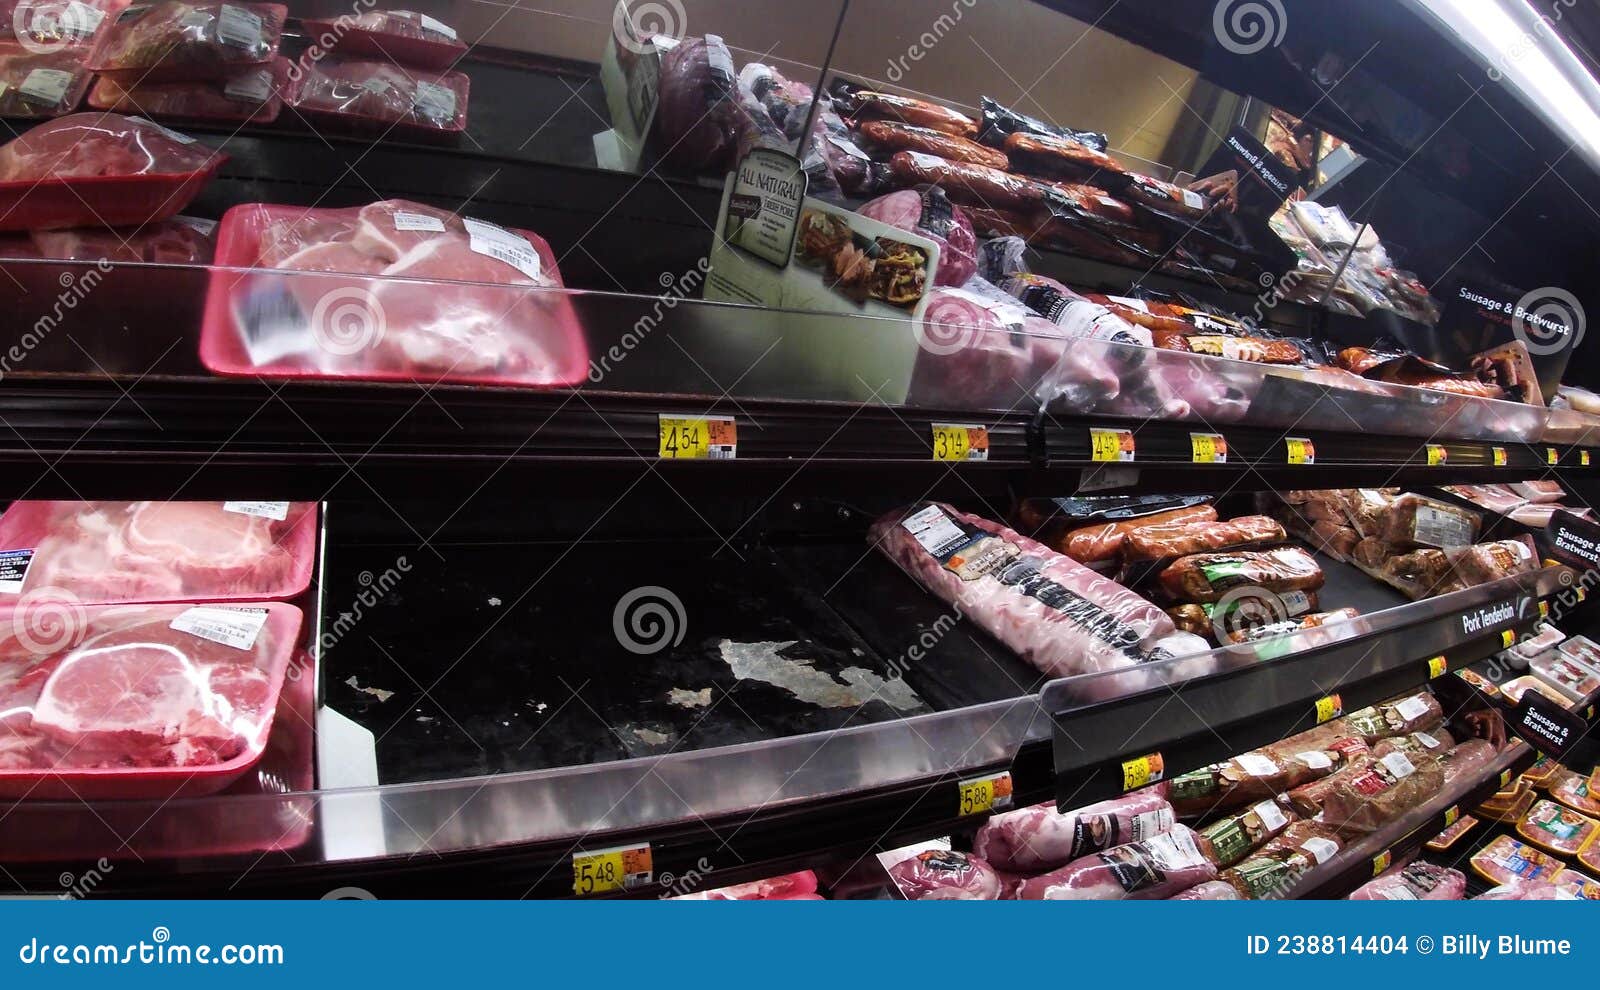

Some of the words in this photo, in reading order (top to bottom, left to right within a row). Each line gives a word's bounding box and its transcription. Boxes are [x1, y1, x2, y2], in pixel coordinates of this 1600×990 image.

[741, 167, 755, 187] ALL
[757, 173, 801, 201] NATURAL
[1459, 287, 1502, 311] Sausage
[1503, 302, 1513, 315] &
[1515, 306, 1570, 336] Bratwurst
[1555, 536, 1599, 562] Bratwurst
[1558, 527, 1594, 549] Sausage
[1462, 611, 1481, 634] Pork
[1479, 602, 1515, 628] Tenderloin
[1523, 716, 1564, 746] Bratwurst
[1527, 706, 1561, 733] Sausage
[1560, 727, 1569, 737] &
